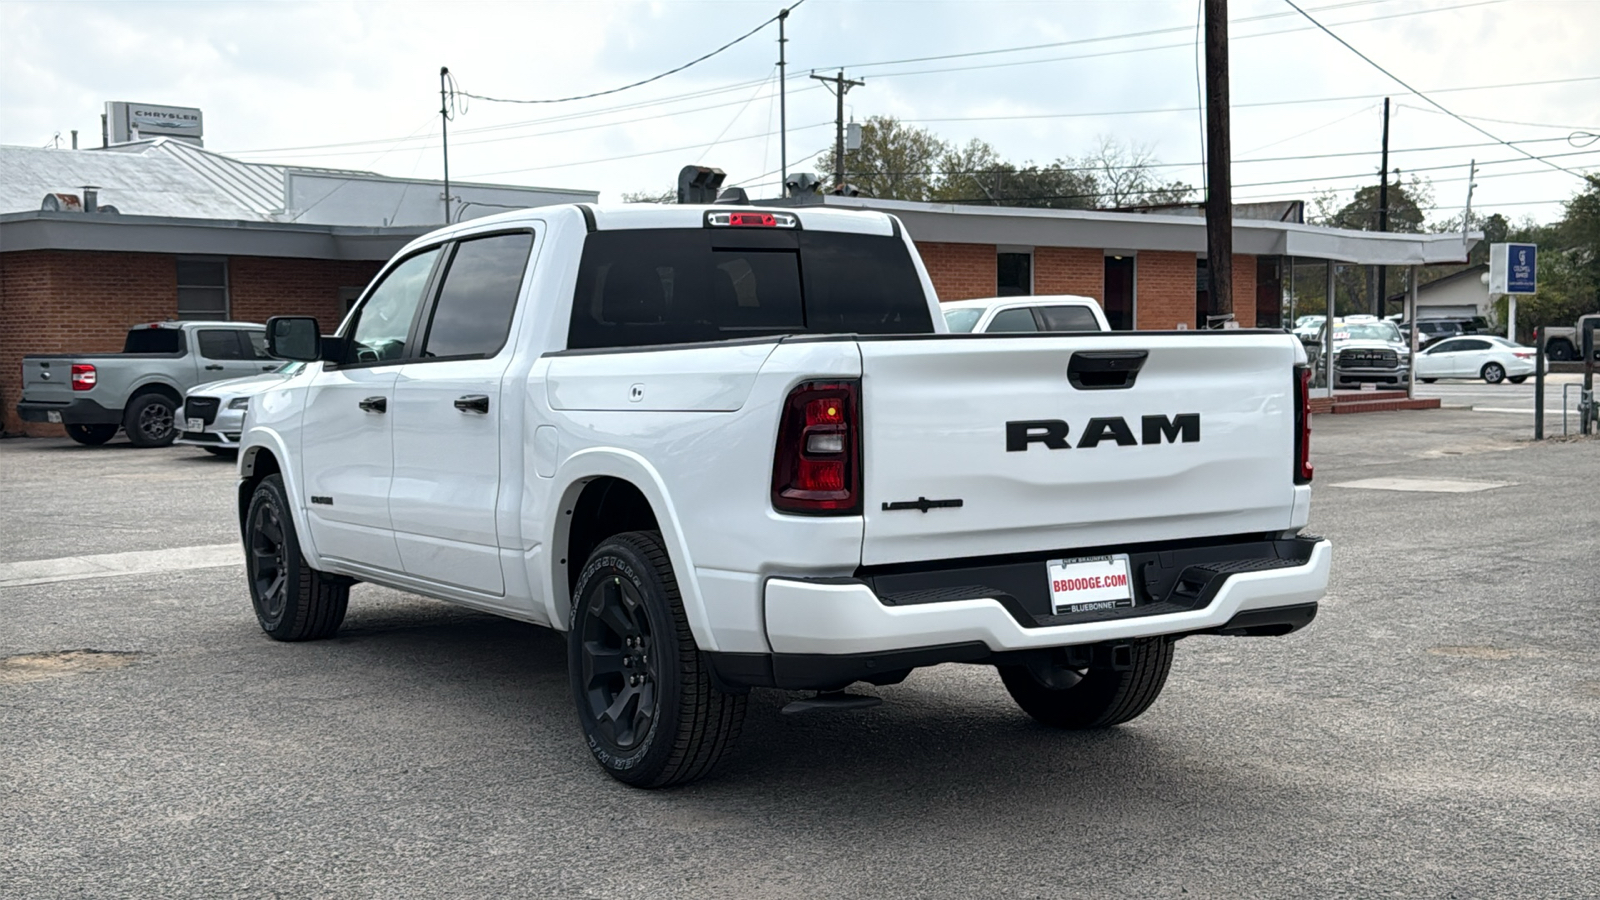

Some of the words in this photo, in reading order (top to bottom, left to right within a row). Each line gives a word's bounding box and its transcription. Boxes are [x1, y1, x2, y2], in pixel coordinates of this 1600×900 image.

[135, 110, 198, 121] CHRYSLER
[1006, 413, 1200, 452] RAM
[1053, 574, 1127, 592] BBDODGE.COM
[1071, 601, 1116, 612] BLUEBONNET
